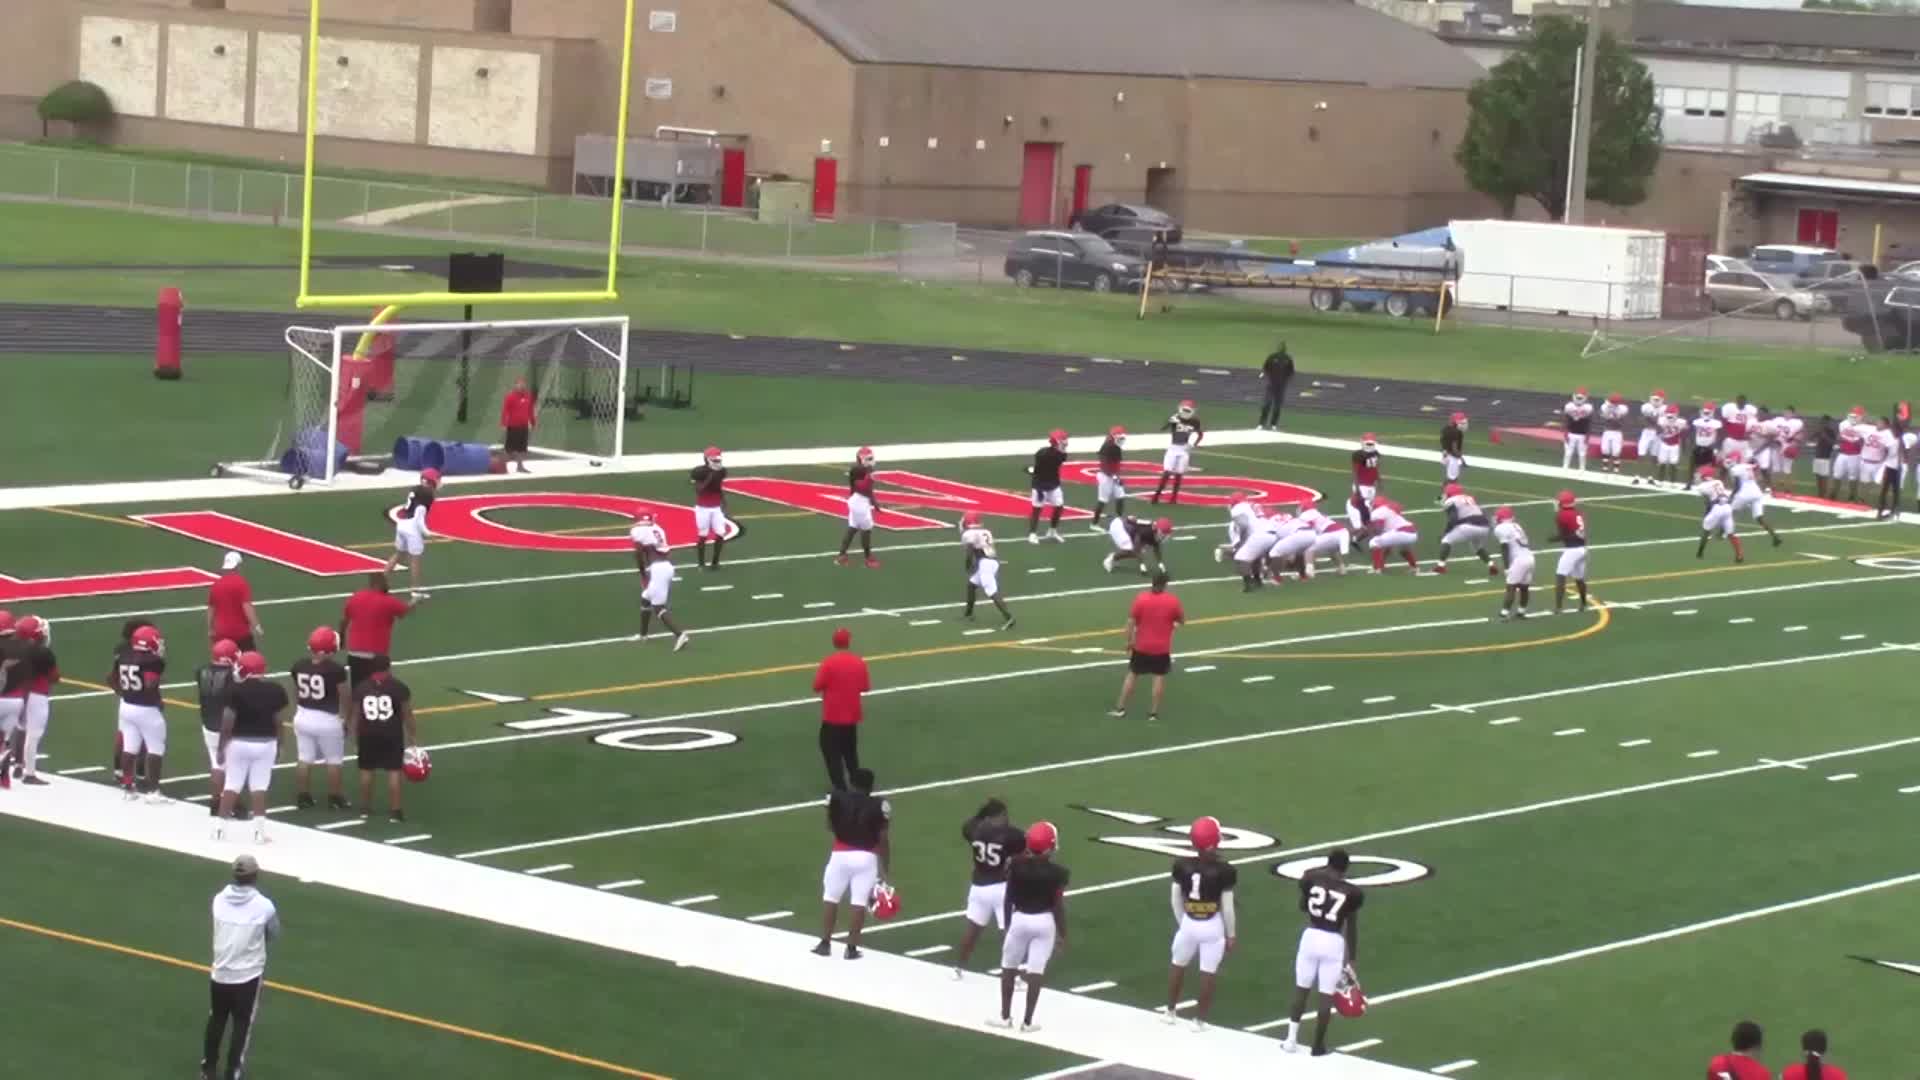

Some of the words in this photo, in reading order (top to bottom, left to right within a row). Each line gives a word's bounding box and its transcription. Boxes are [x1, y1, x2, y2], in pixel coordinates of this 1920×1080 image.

[119, 664, 143, 691] 55
[297, 672, 326, 700] 59
[363, 695, 394, 721] 89
[503, 706, 738, 751] 10
[972, 840, 1003, 867] 35
[1189, 872, 1201, 900] 1
[1307, 885, 1347, 922] 27
